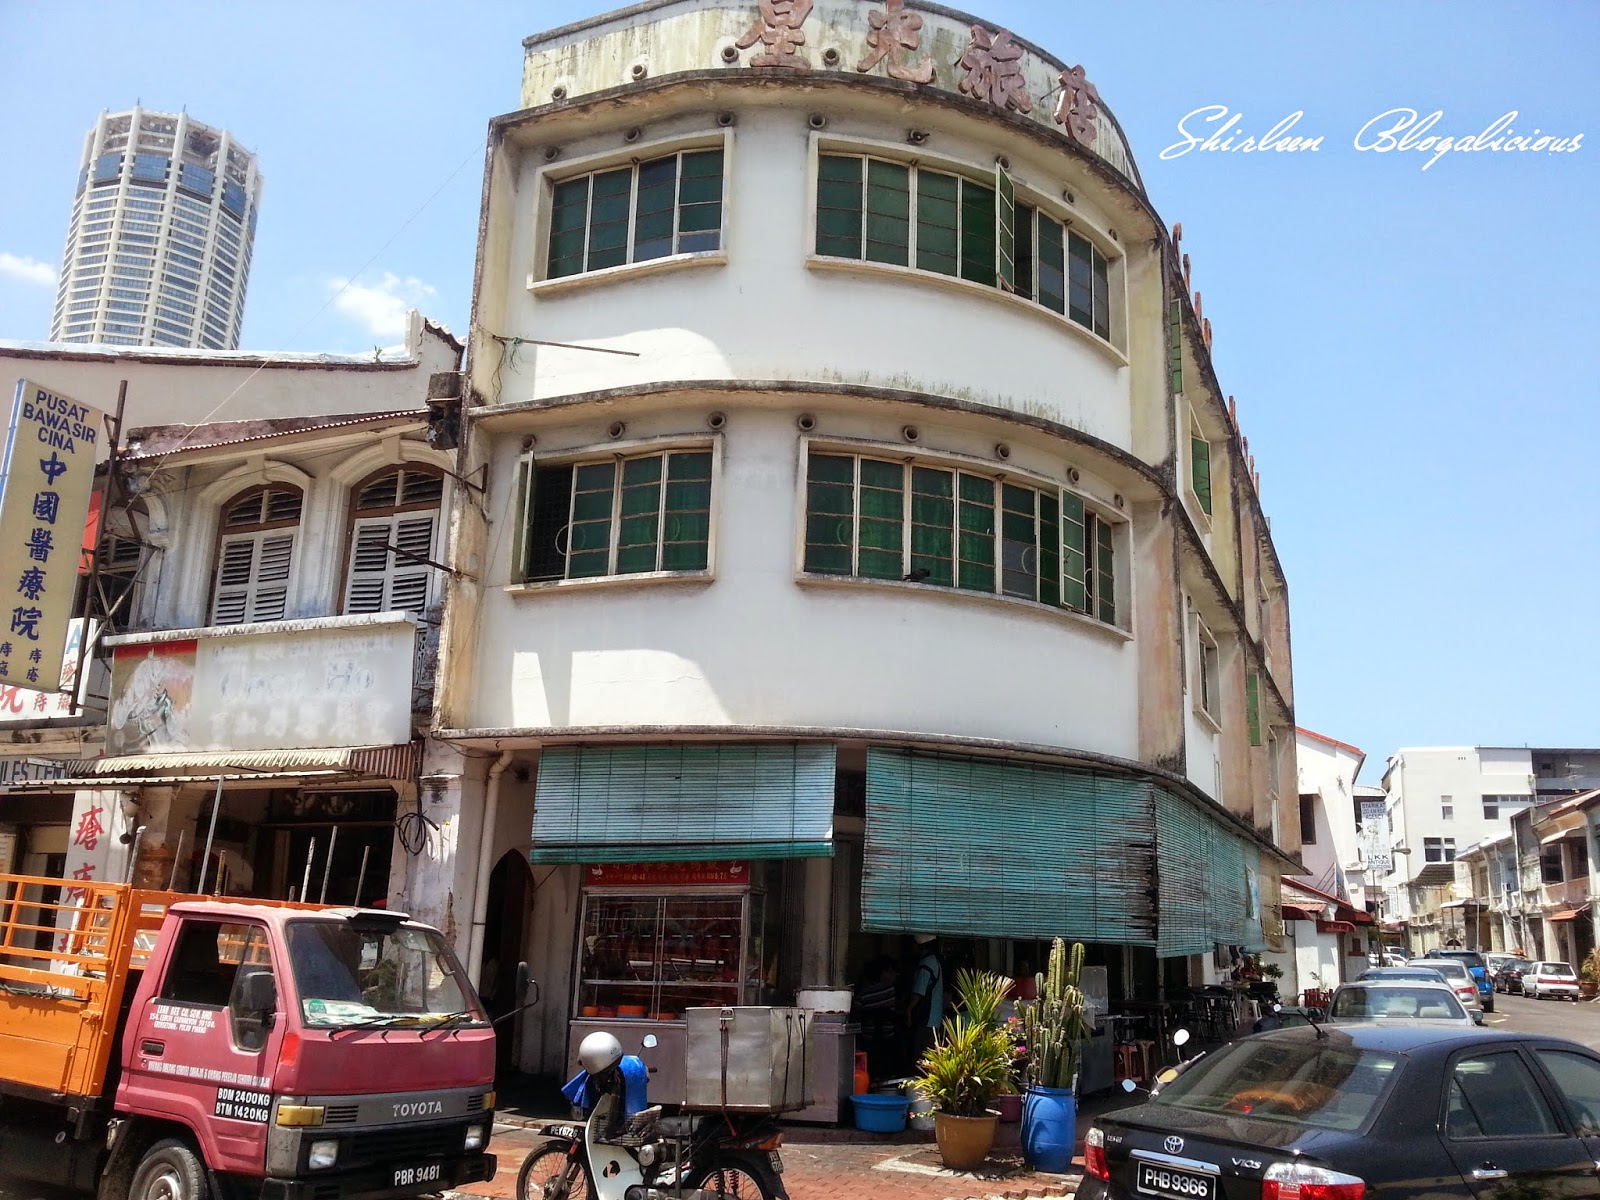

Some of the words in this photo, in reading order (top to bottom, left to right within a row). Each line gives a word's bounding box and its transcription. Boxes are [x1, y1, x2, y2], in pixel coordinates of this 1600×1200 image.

[36, 390, 89, 423] PUSAT
[23, 402, 96, 444] BAWASIR
[38, 427, 75, 454] CINA
[11, 451, 67, 641] 中國醫療院
[218, 1087, 234, 1101] BDM
[235, 1090, 271, 1106] 2400KG
[215, 1102, 232, 1116] BTM
[234, 1105, 269, 1121] 1420KG
[392, 1101, 442, 1117] TOYOTA
[394, 1168, 414, 1186] PBR
[416, 1164, 440, 1182] 9481
